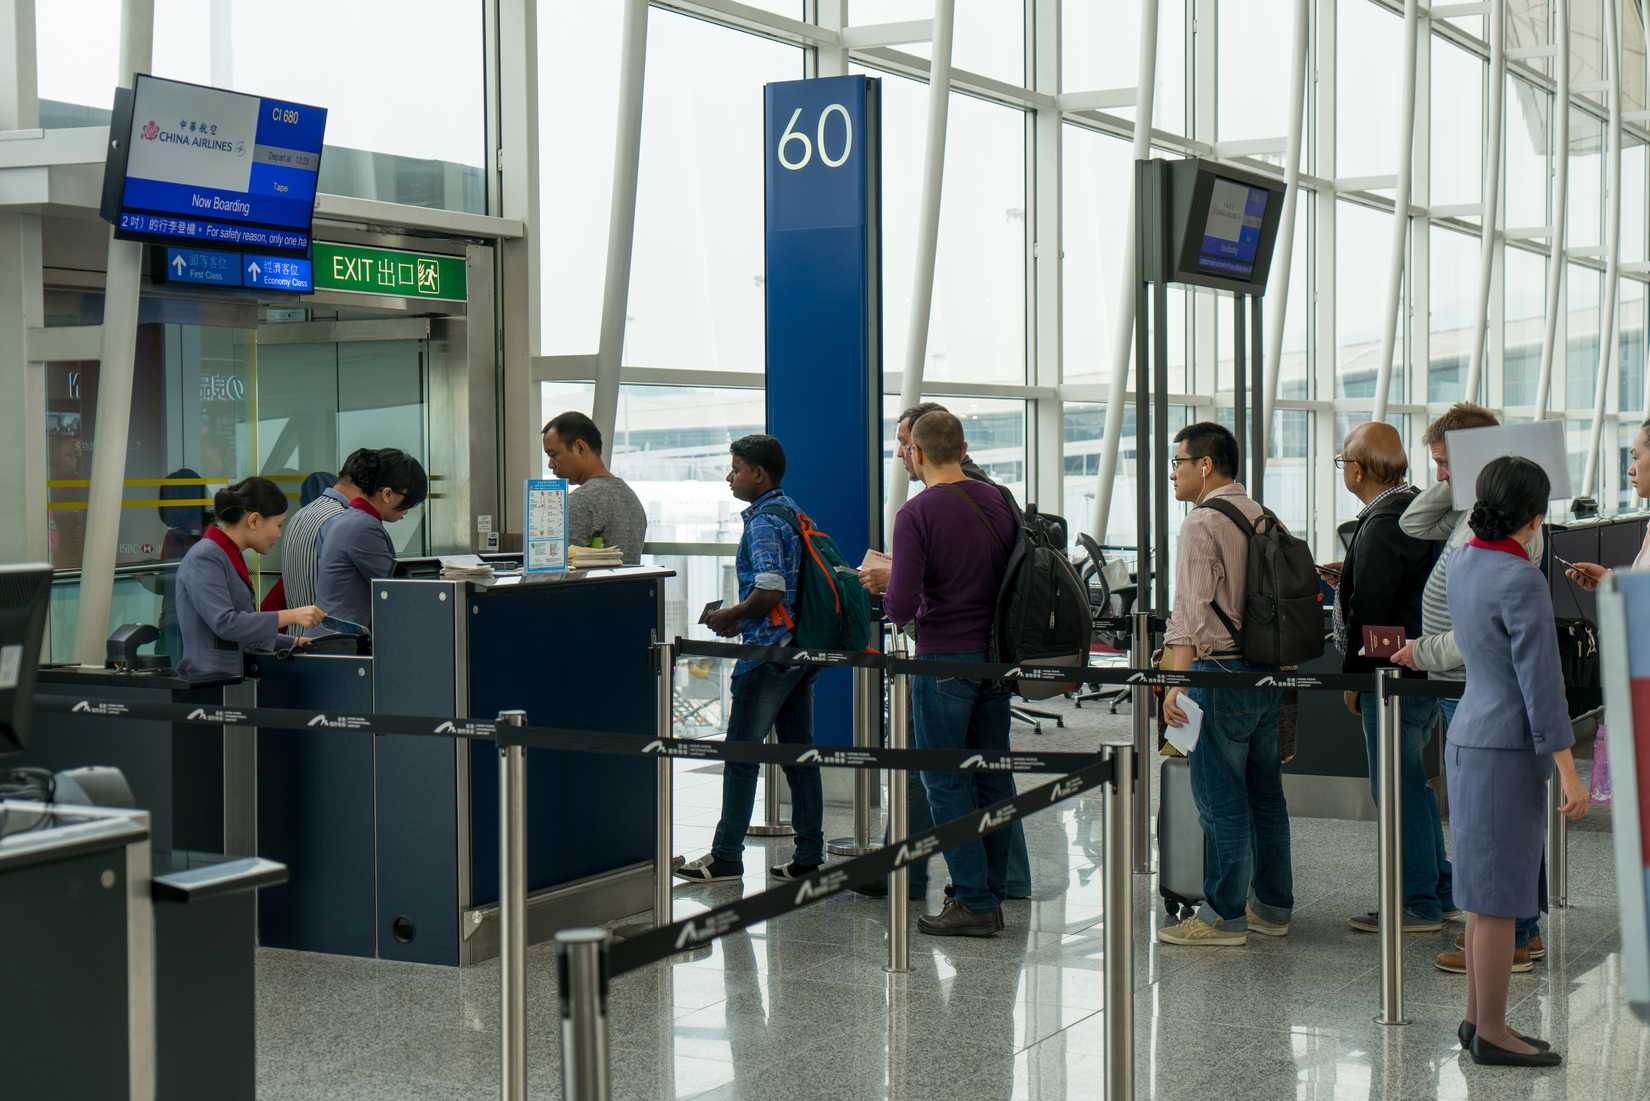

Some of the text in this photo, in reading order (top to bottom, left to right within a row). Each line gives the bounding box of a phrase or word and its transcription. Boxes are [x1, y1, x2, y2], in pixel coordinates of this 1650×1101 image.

[272, 108, 299, 125] CI 680
[159, 131, 233, 152] CHINA AIRLINES
[777, 103, 853, 171] 60
[192, 193, 250, 217] Now Boarding
[206, 225, 219, 238] For
[219, 227, 241, 243] safety
[269, 234, 284, 247] only
[284, 236, 297, 247] one
[263, 275, 308, 288] Economy Class
[333, 255, 414, 288] EXIT 出口
